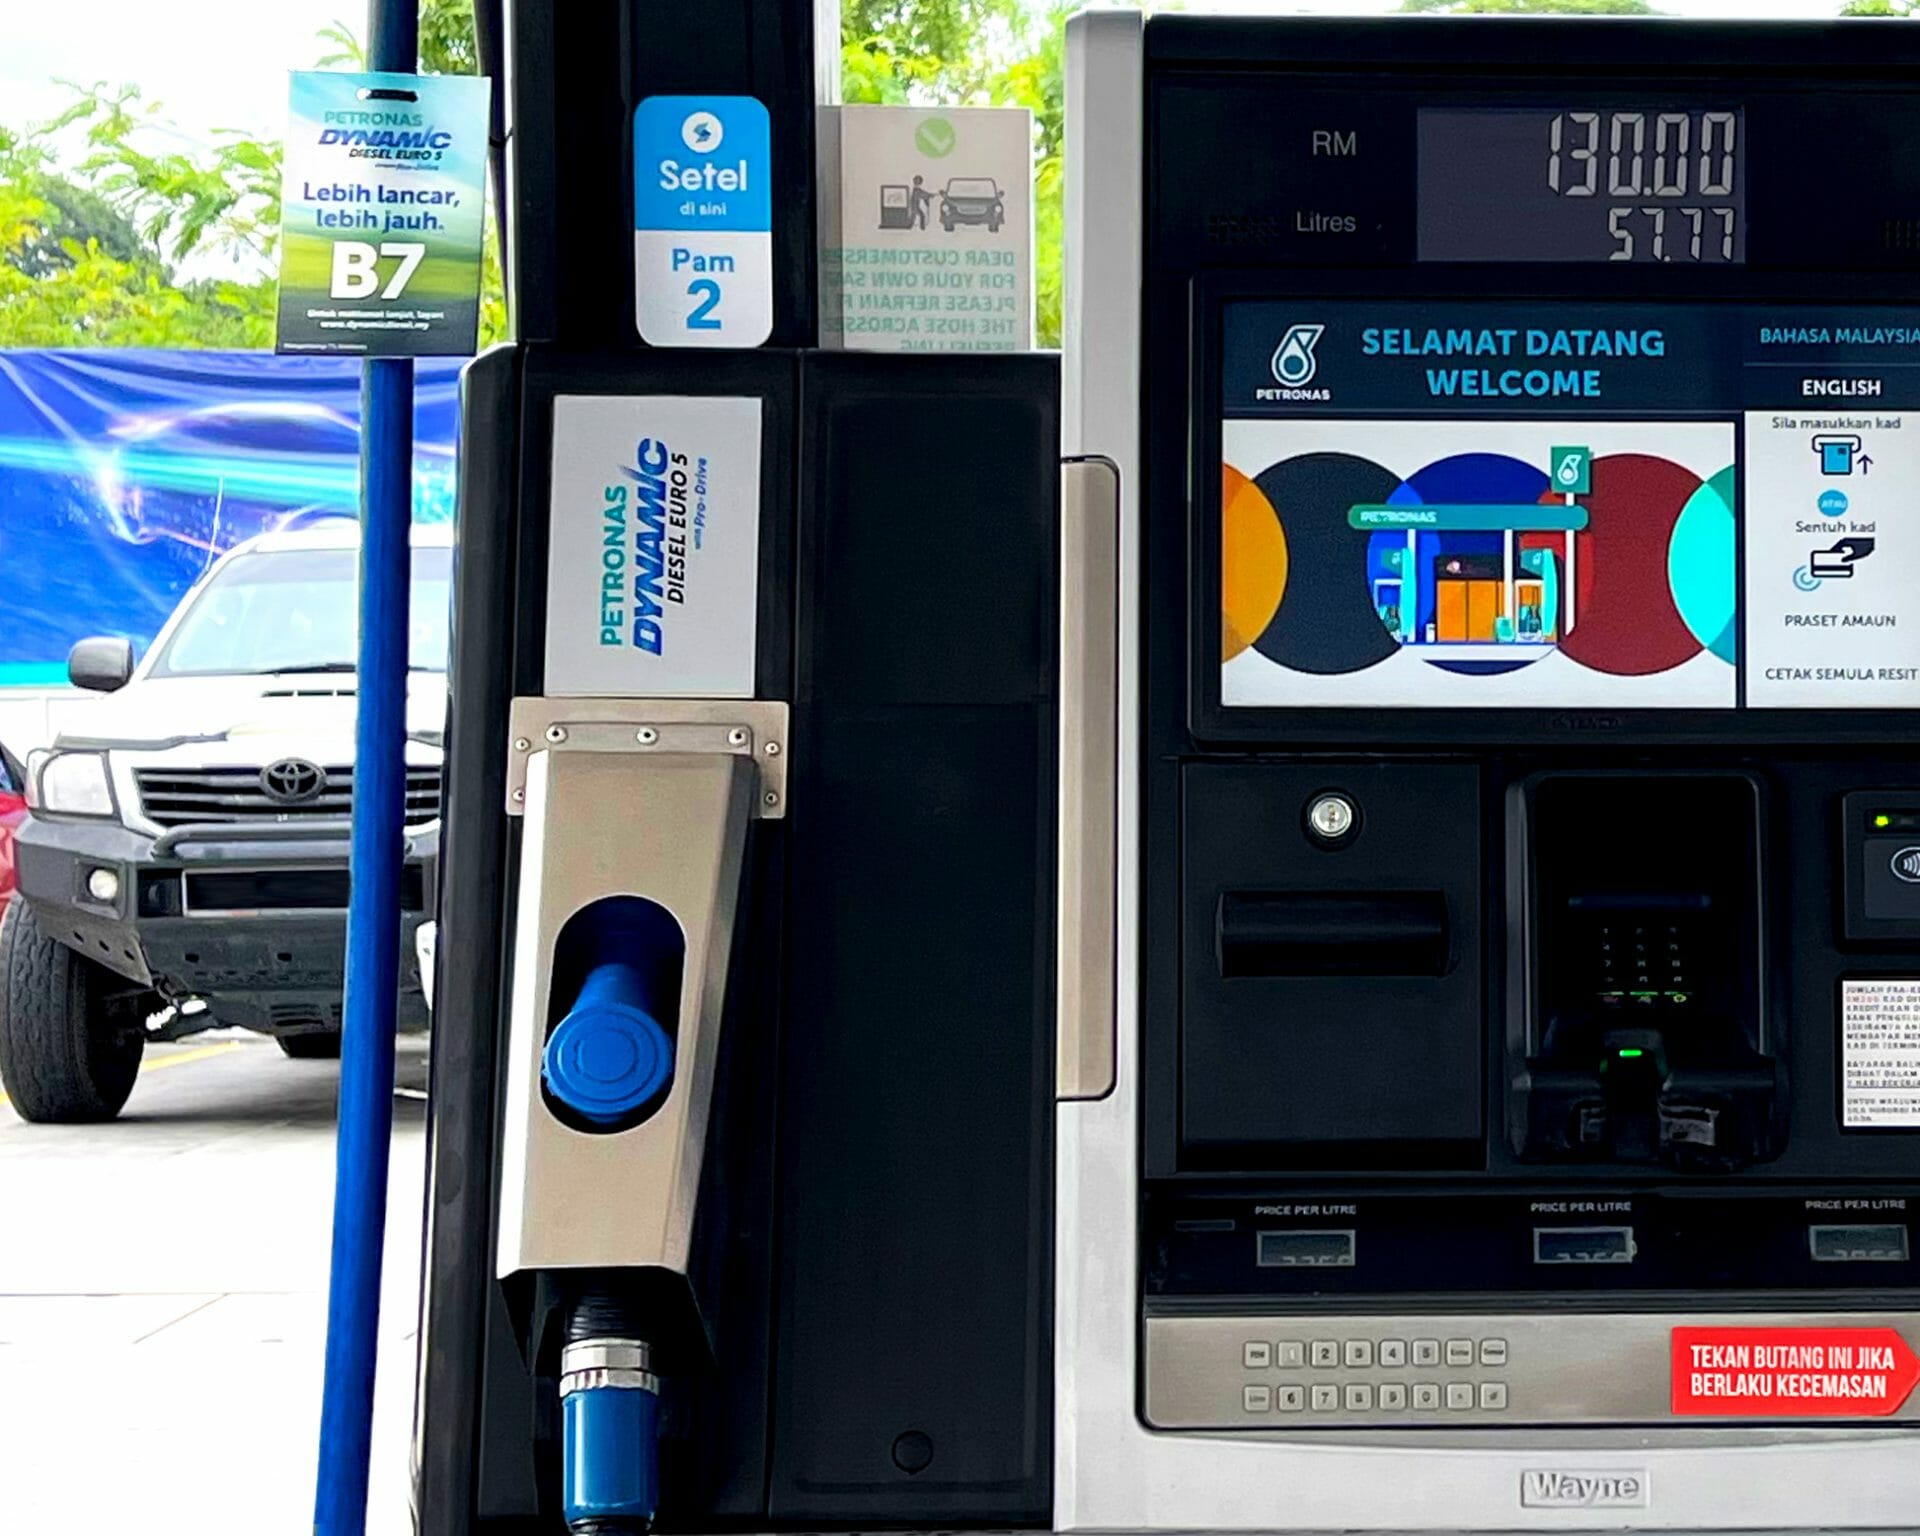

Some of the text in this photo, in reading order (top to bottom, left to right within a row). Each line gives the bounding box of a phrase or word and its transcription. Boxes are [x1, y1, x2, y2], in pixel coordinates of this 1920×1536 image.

[324, 111, 423, 127] PETRONAS
[318, 126, 452, 149] DYNAMIC
[1312, 131, 1356, 156] RM
[349, 148, 392, 160] DIESEL
[395, 149, 432, 161] EURO
[1547, 112, 1737, 196] 130.00
[659, 159, 748, 192] Setel
[303, 182, 461, 208] Lebih lancar,
[679, 201, 727, 216] di sini
[316, 208, 445, 234] lebih jauh.
[1296, 211, 1357, 233] Litres
[1608, 207, 1735, 262] 57.77
[329, 240, 427, 301] B7
[671, 248, 735, 273] Pam
[685, 279, 722, 330] 2
[1362, 329, 1665, 357] SELAMAT DATANG
[1760, 328, 1920, 344] BAHASA MALAYSIA
[1256, 388, 1331, 401] PETRONAS
[1425, 369, 1602, 397] WELCOME
[1802, 379, 1882, 396] ENGLISH
[1772, 416, 1902, 429] Sila masukkan kad
[667, 452, 689, 605] DIESEL EURO 5
[1360, 511, 1437, 523] PETRONAS
[1796, 521, 1876, 533] Sentuh kad
[620, 438, 669, 657] DYNAMIC
[600, 485, 627, 646] PETRONAS
[1784, 614, 1897, 627] PRASET AMAUN
[1765, 668, 1919, 681] CETAK SEMULA RESIT
[1255, 1204, 1356, 1215] PRICE PER LITRE
[1530, 1201, 1632, 1212] PRICE PER LITRE
[1805, 1199, 1906, 1209] PRICE PER LITRE
[1321, 1347, 1330, 1360] 2
[1388, 1347, 1397, 1359] 4
[1690, 1345, 1896, 1371] TEKAN BUTANG INI JIKA
[1690, 1373, 1887, 1398] BERLAKU KECEMASAN
[1320, 1391, 1330, 1404] 7
[1529, 1472, 1640, 1507] Wayne
